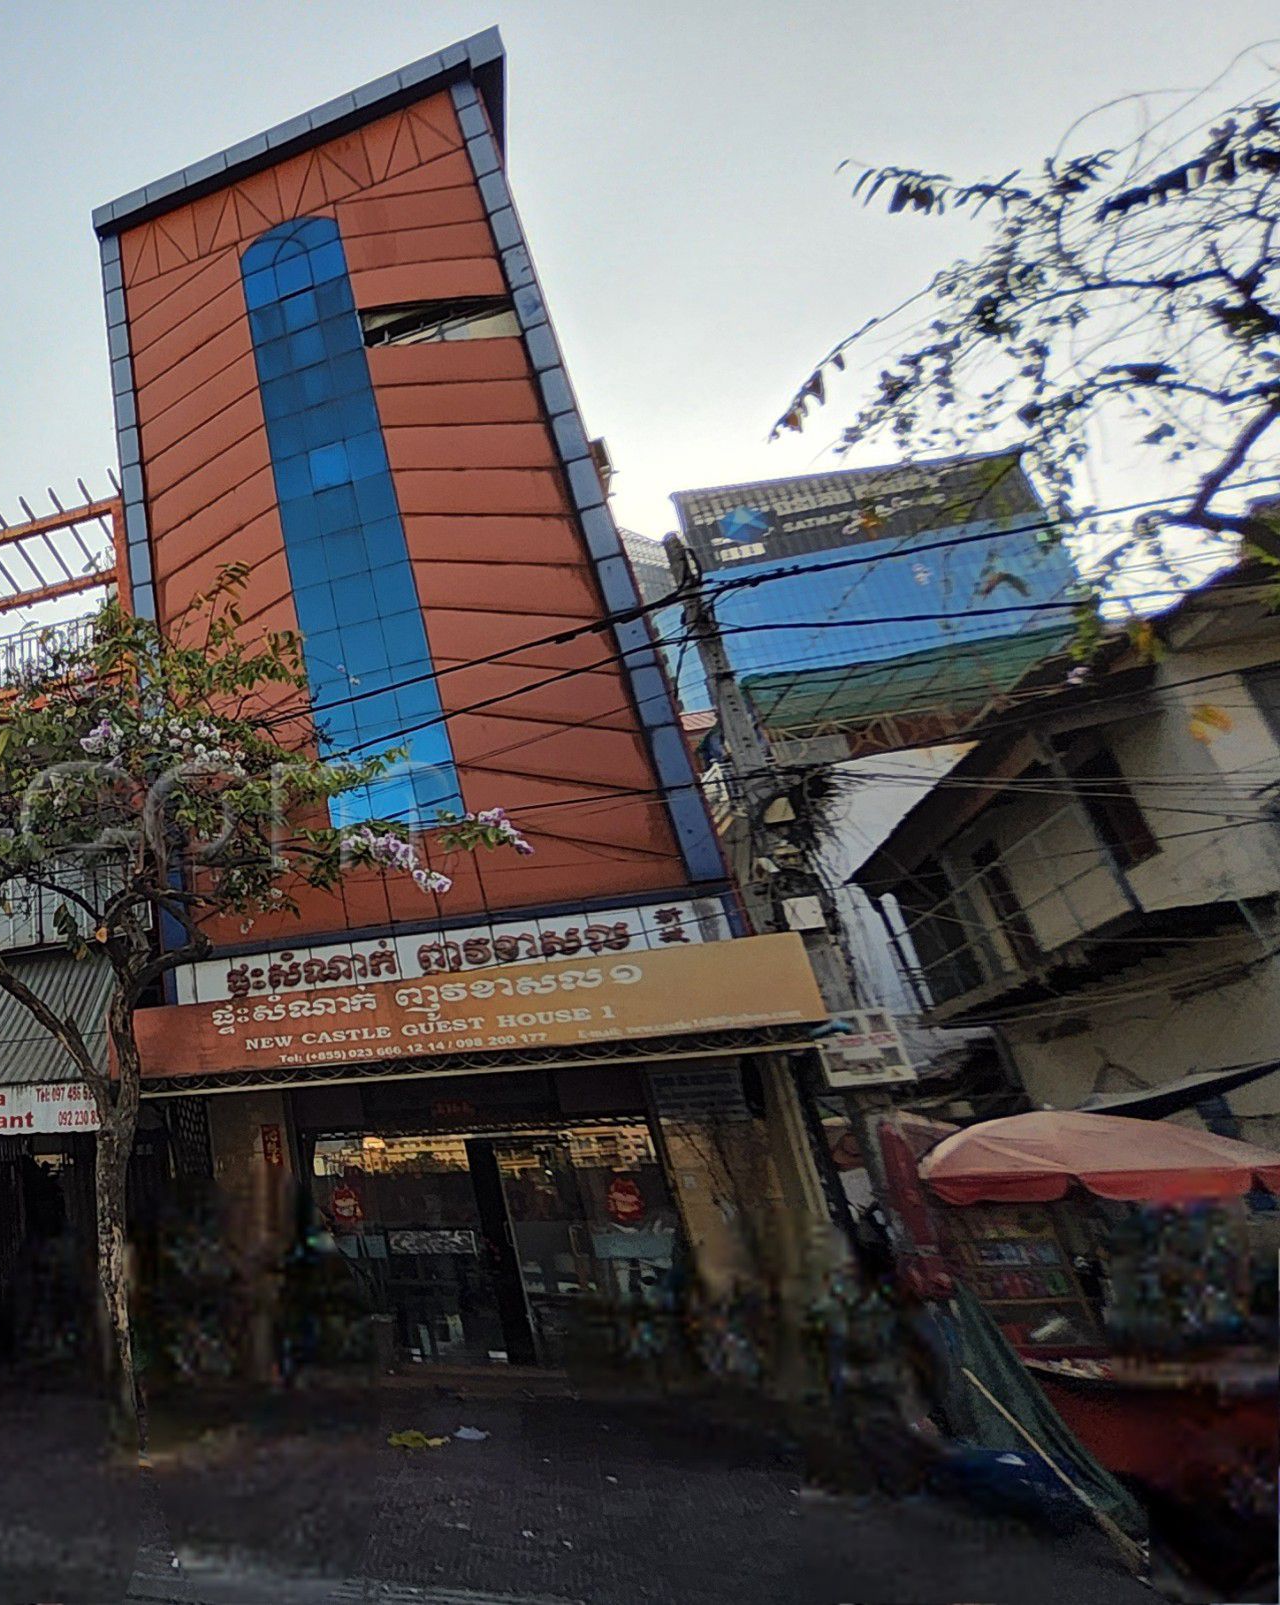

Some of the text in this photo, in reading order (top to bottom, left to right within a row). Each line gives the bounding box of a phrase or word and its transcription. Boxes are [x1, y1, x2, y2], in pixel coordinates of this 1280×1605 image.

[245, 1005, 616, 1050] NEW CASTLE GUEST HOUSE 1
[279, 1053, 303, 1063] Tel:
[305, 1050, 347, 1063] (+855)
[349, 1048, 374, 1059] 023
[407, 1043, 424, 1054] 12
[427, 1041, 445, 1052] 14
[36, 1087, 50, 1102] Tel:
